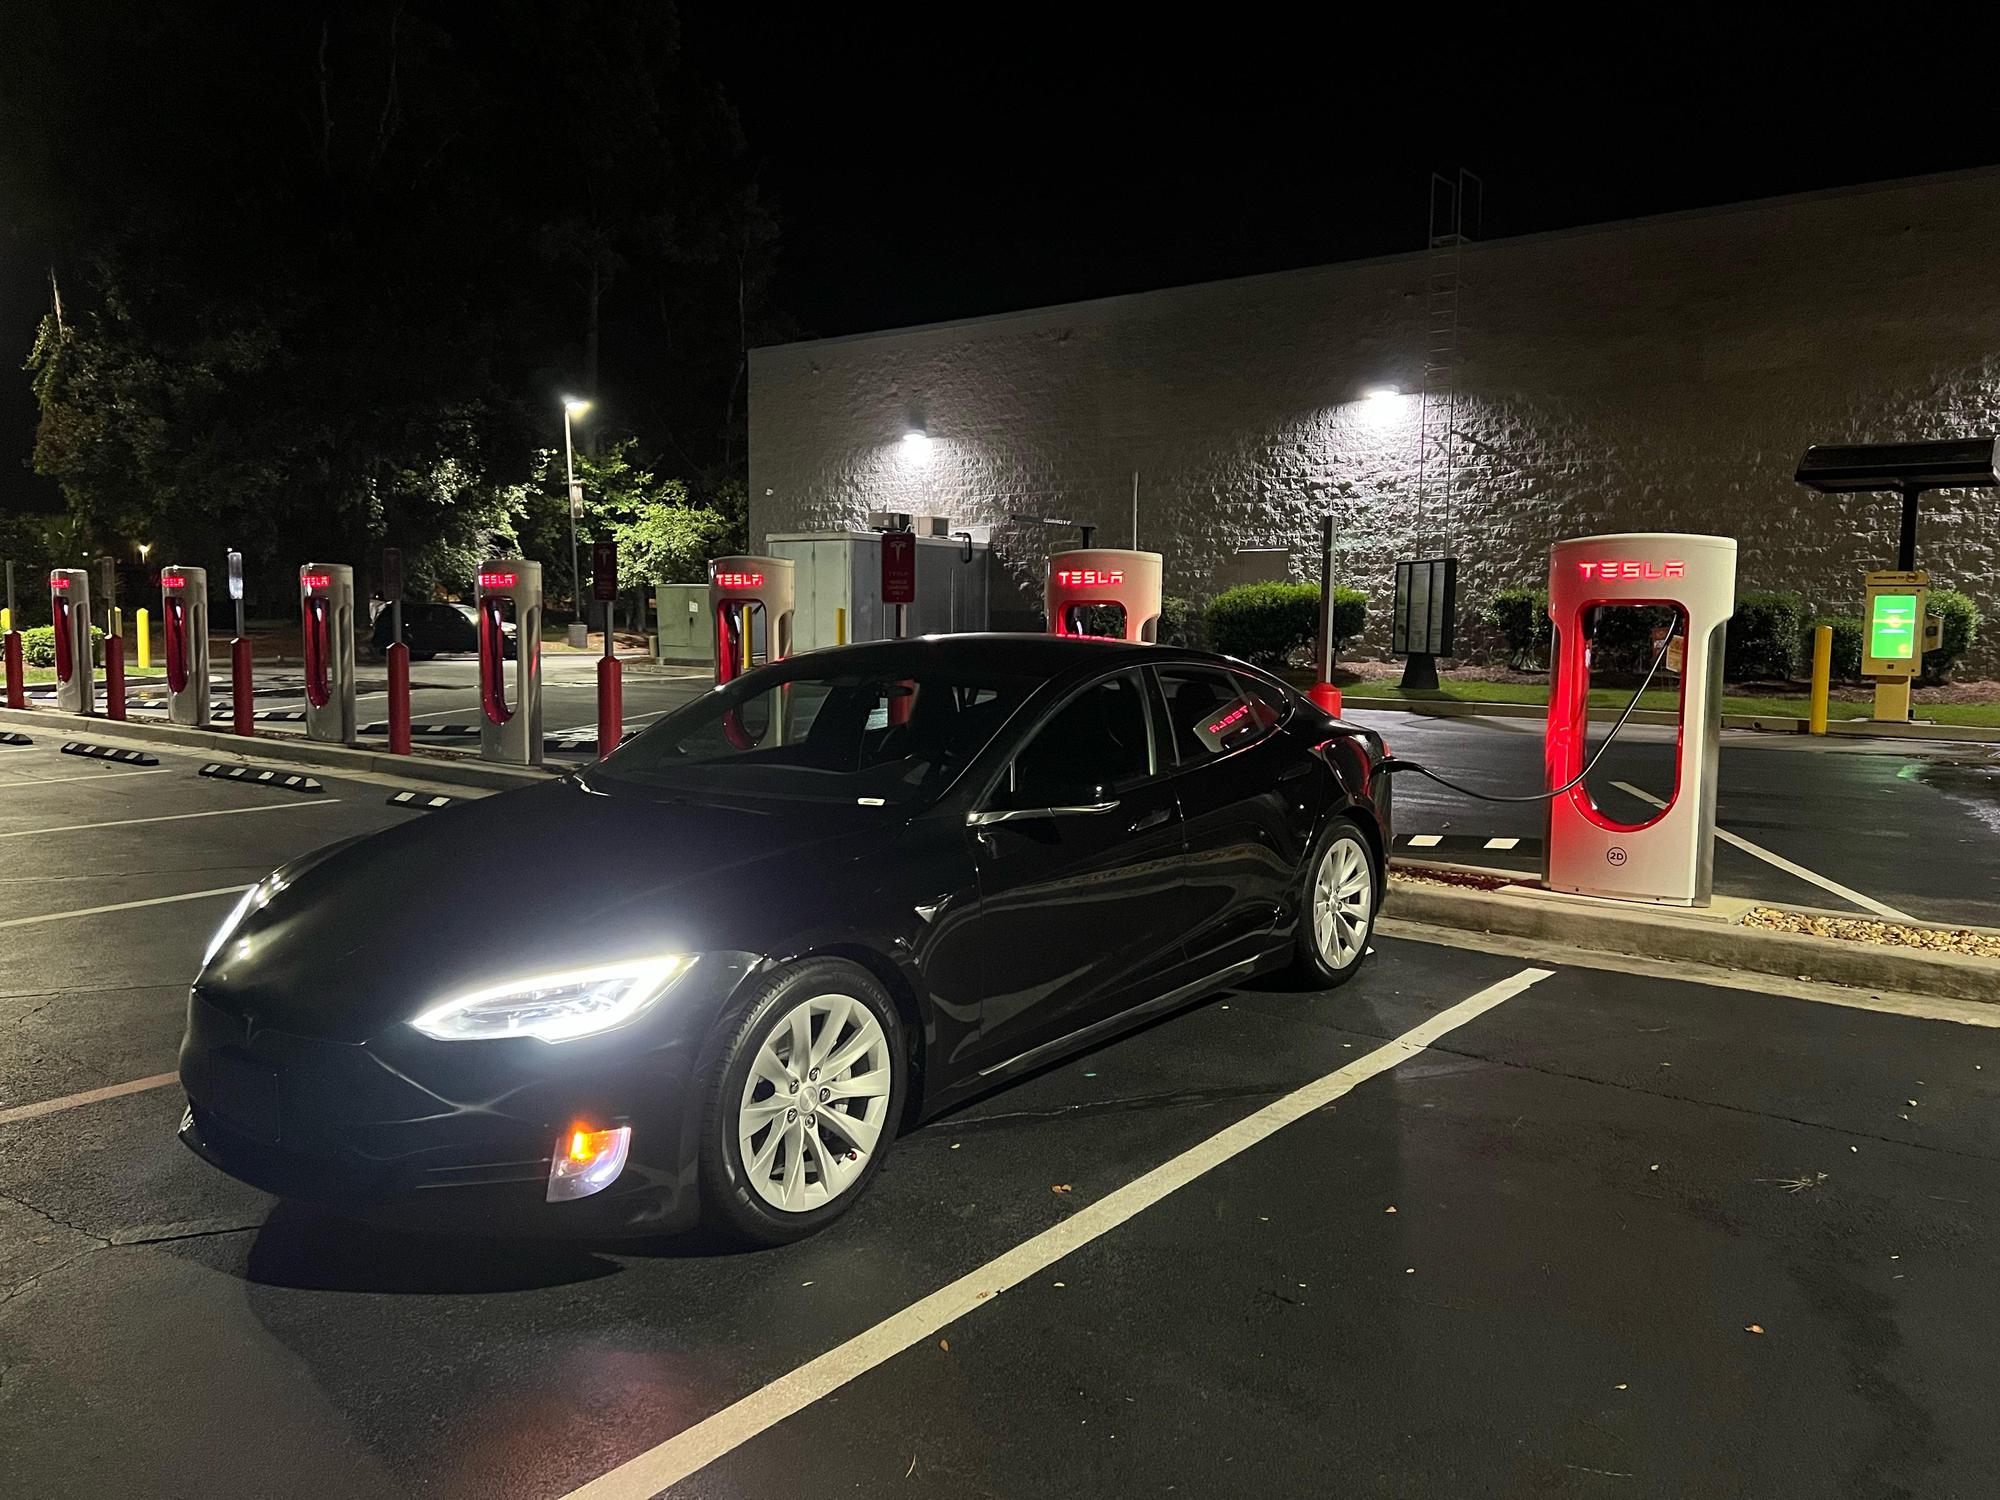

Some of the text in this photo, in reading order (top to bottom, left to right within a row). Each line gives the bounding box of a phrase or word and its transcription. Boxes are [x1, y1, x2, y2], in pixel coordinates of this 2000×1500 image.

[1578, 562, 1685, 578] TESLA
[301, 576, 329, 586] TESLA
[478, 574, 513, 585] TESLA
[716, 573, 763, 585] TESLA
[1058, 571, 1123, 584] TESLA
[1610, 852, 1624, 860] 2D
